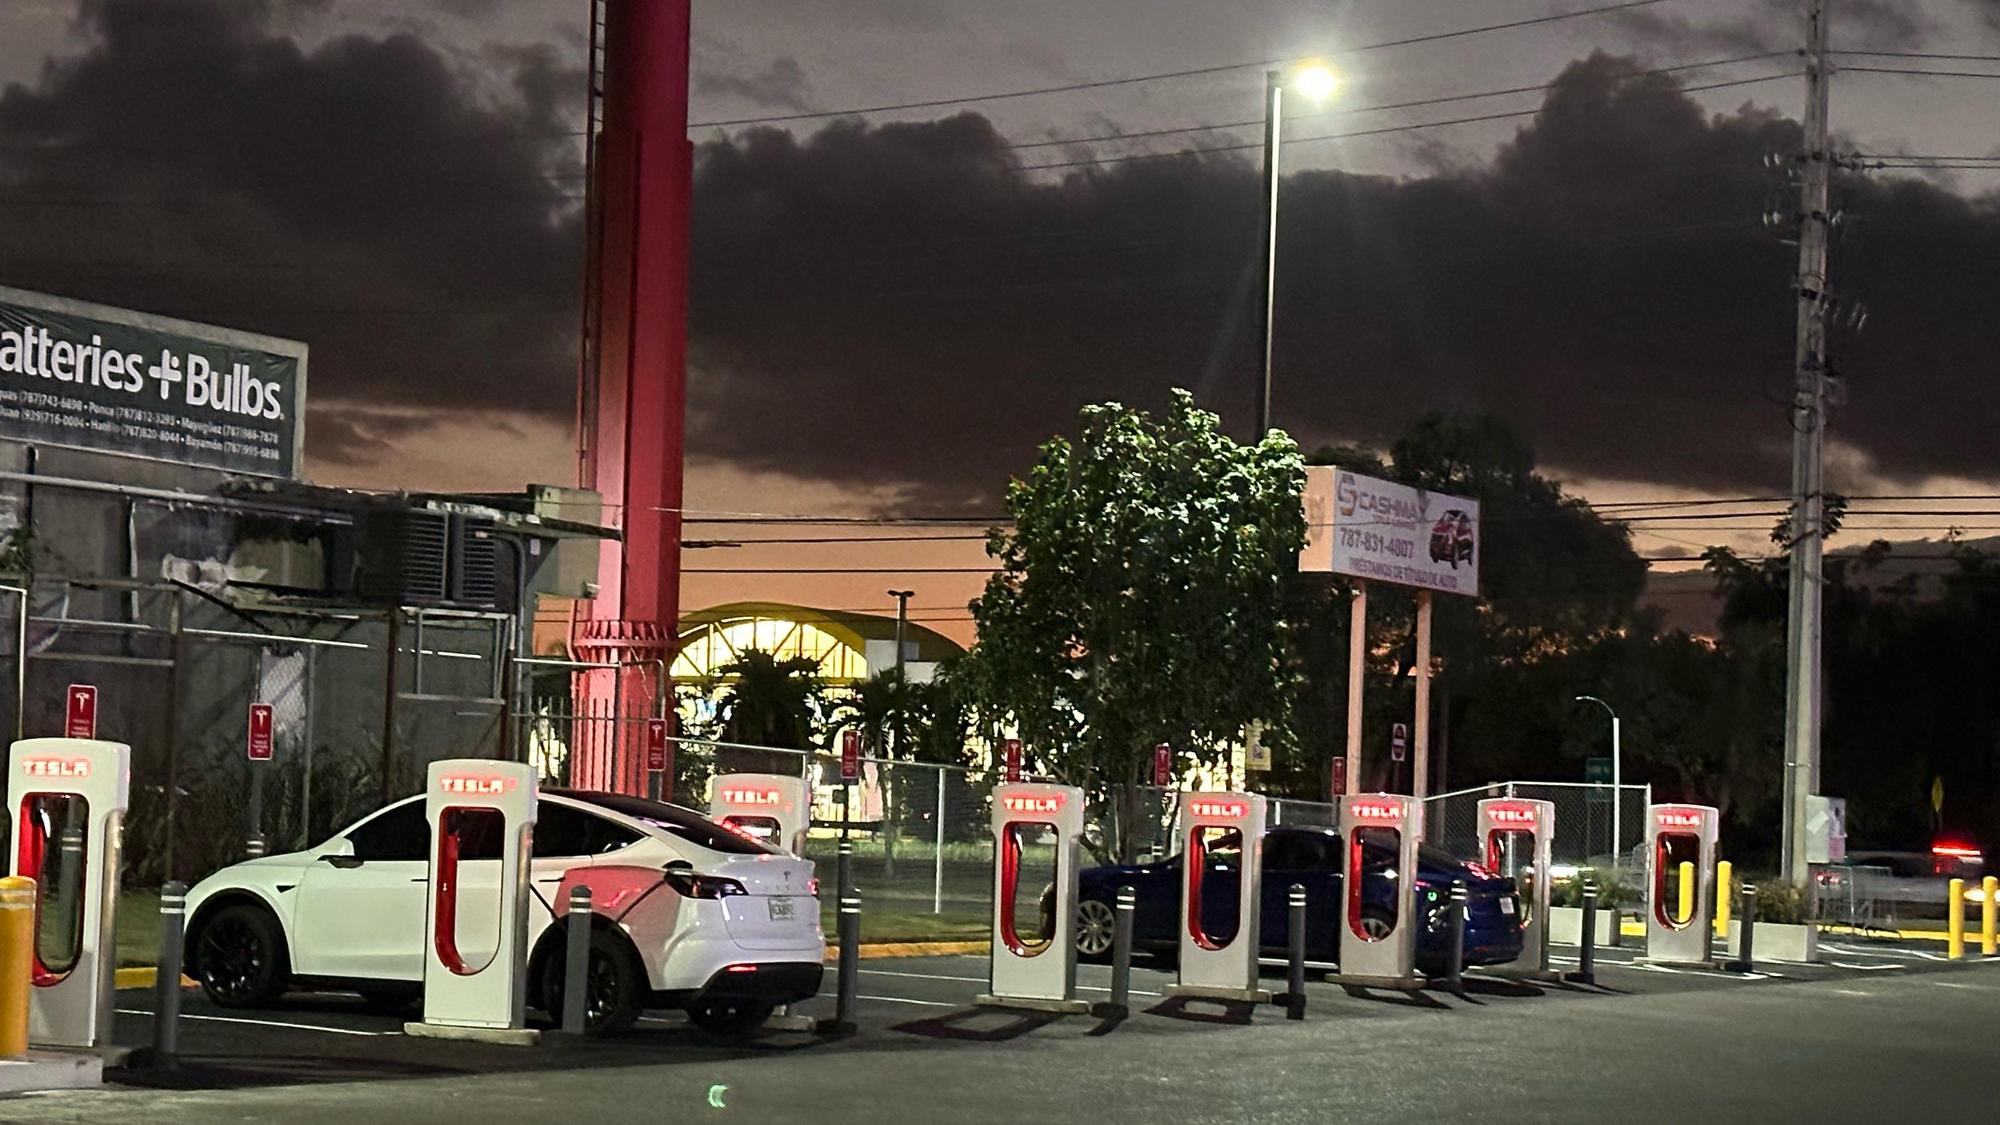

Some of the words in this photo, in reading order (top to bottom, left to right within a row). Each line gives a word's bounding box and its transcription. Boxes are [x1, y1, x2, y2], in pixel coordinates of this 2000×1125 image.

[186, 353, 281, 420] Bulbs
[89, 401, 114, 417] Ponce
[22, 760, 90, 776] TESLA
[440, 778, 503, 793] TESLA
[722, 789, 780, 805] TESLA
[1003, 797, 1058, 811] TESLA
[1191, 803, 1241, 816] TESLA
[1351, 805, 1400, 818] TESLA
[1487, 809, 1535, 822] TESLA
[1657, 814, 1701, 825] TESLA
